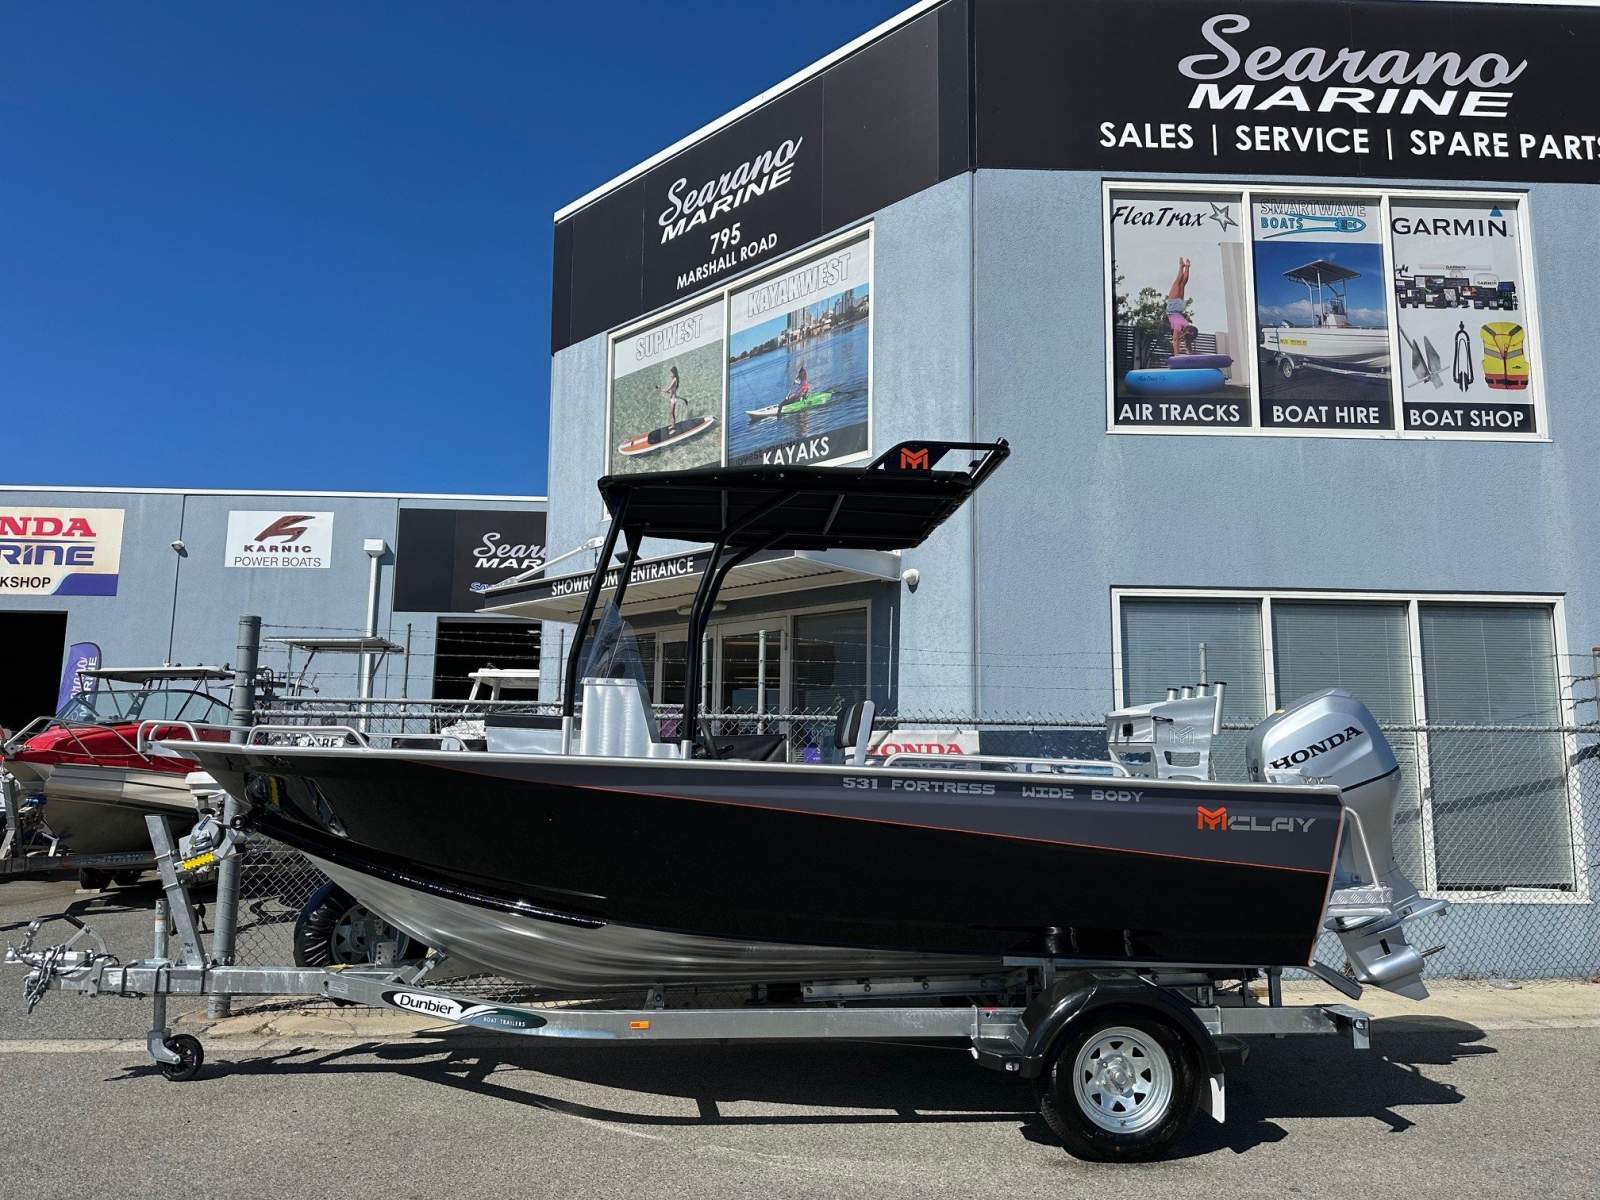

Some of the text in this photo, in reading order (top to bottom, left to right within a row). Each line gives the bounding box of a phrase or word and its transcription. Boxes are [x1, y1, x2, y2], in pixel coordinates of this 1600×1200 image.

[1178, 13, 1528, 88] Searano
[1188, 83, 1514, 118] MARINE
[1099, 121, 1600, 160] SALES SERVICE SPARE PART
[658, 136, 803, 227] Searano
[660, 161, 795, 245] MARINE
[1260, 199, 1367, 217] SMARTWAVE
[1110, 205, 1207, 228] FleaTrax
[1260, 216, 1304, 230] BOATS
[1391, 217, 1508, 237] GARMIN
[709, 222, 742, 255] 795
[676, 233, 778, 290] MARSHALL ROAD
[747, 252, 852, 318] KAYAKWEST
[635, 313, 704, 361] SUPWEST
[1118, 403, 1241, 422] AIR TRACKS
[1272, 405, 1380, 424] BOAT HIRE
[1409, 409, 1524, 428] BOAT SHOP
[762, 436, 830, 465] KAYAKS
[243, 544, 313, 553] KARNIC
[234, 556, 322, 568] POWER BOATS
[630, 556, 694, 583] ENTRANCE
[0, 576, 51, 589] KSHOP
[866, 743, 964, 757] ONDA
[1269, 725, 1365, 770] HONDA
[842, 777, 1144, 803] 531 FORTRESS WIDE BODY
[399, 994, 454, 1014] Dunbier
[500, 1019, 526, 1028] TRAILERS
